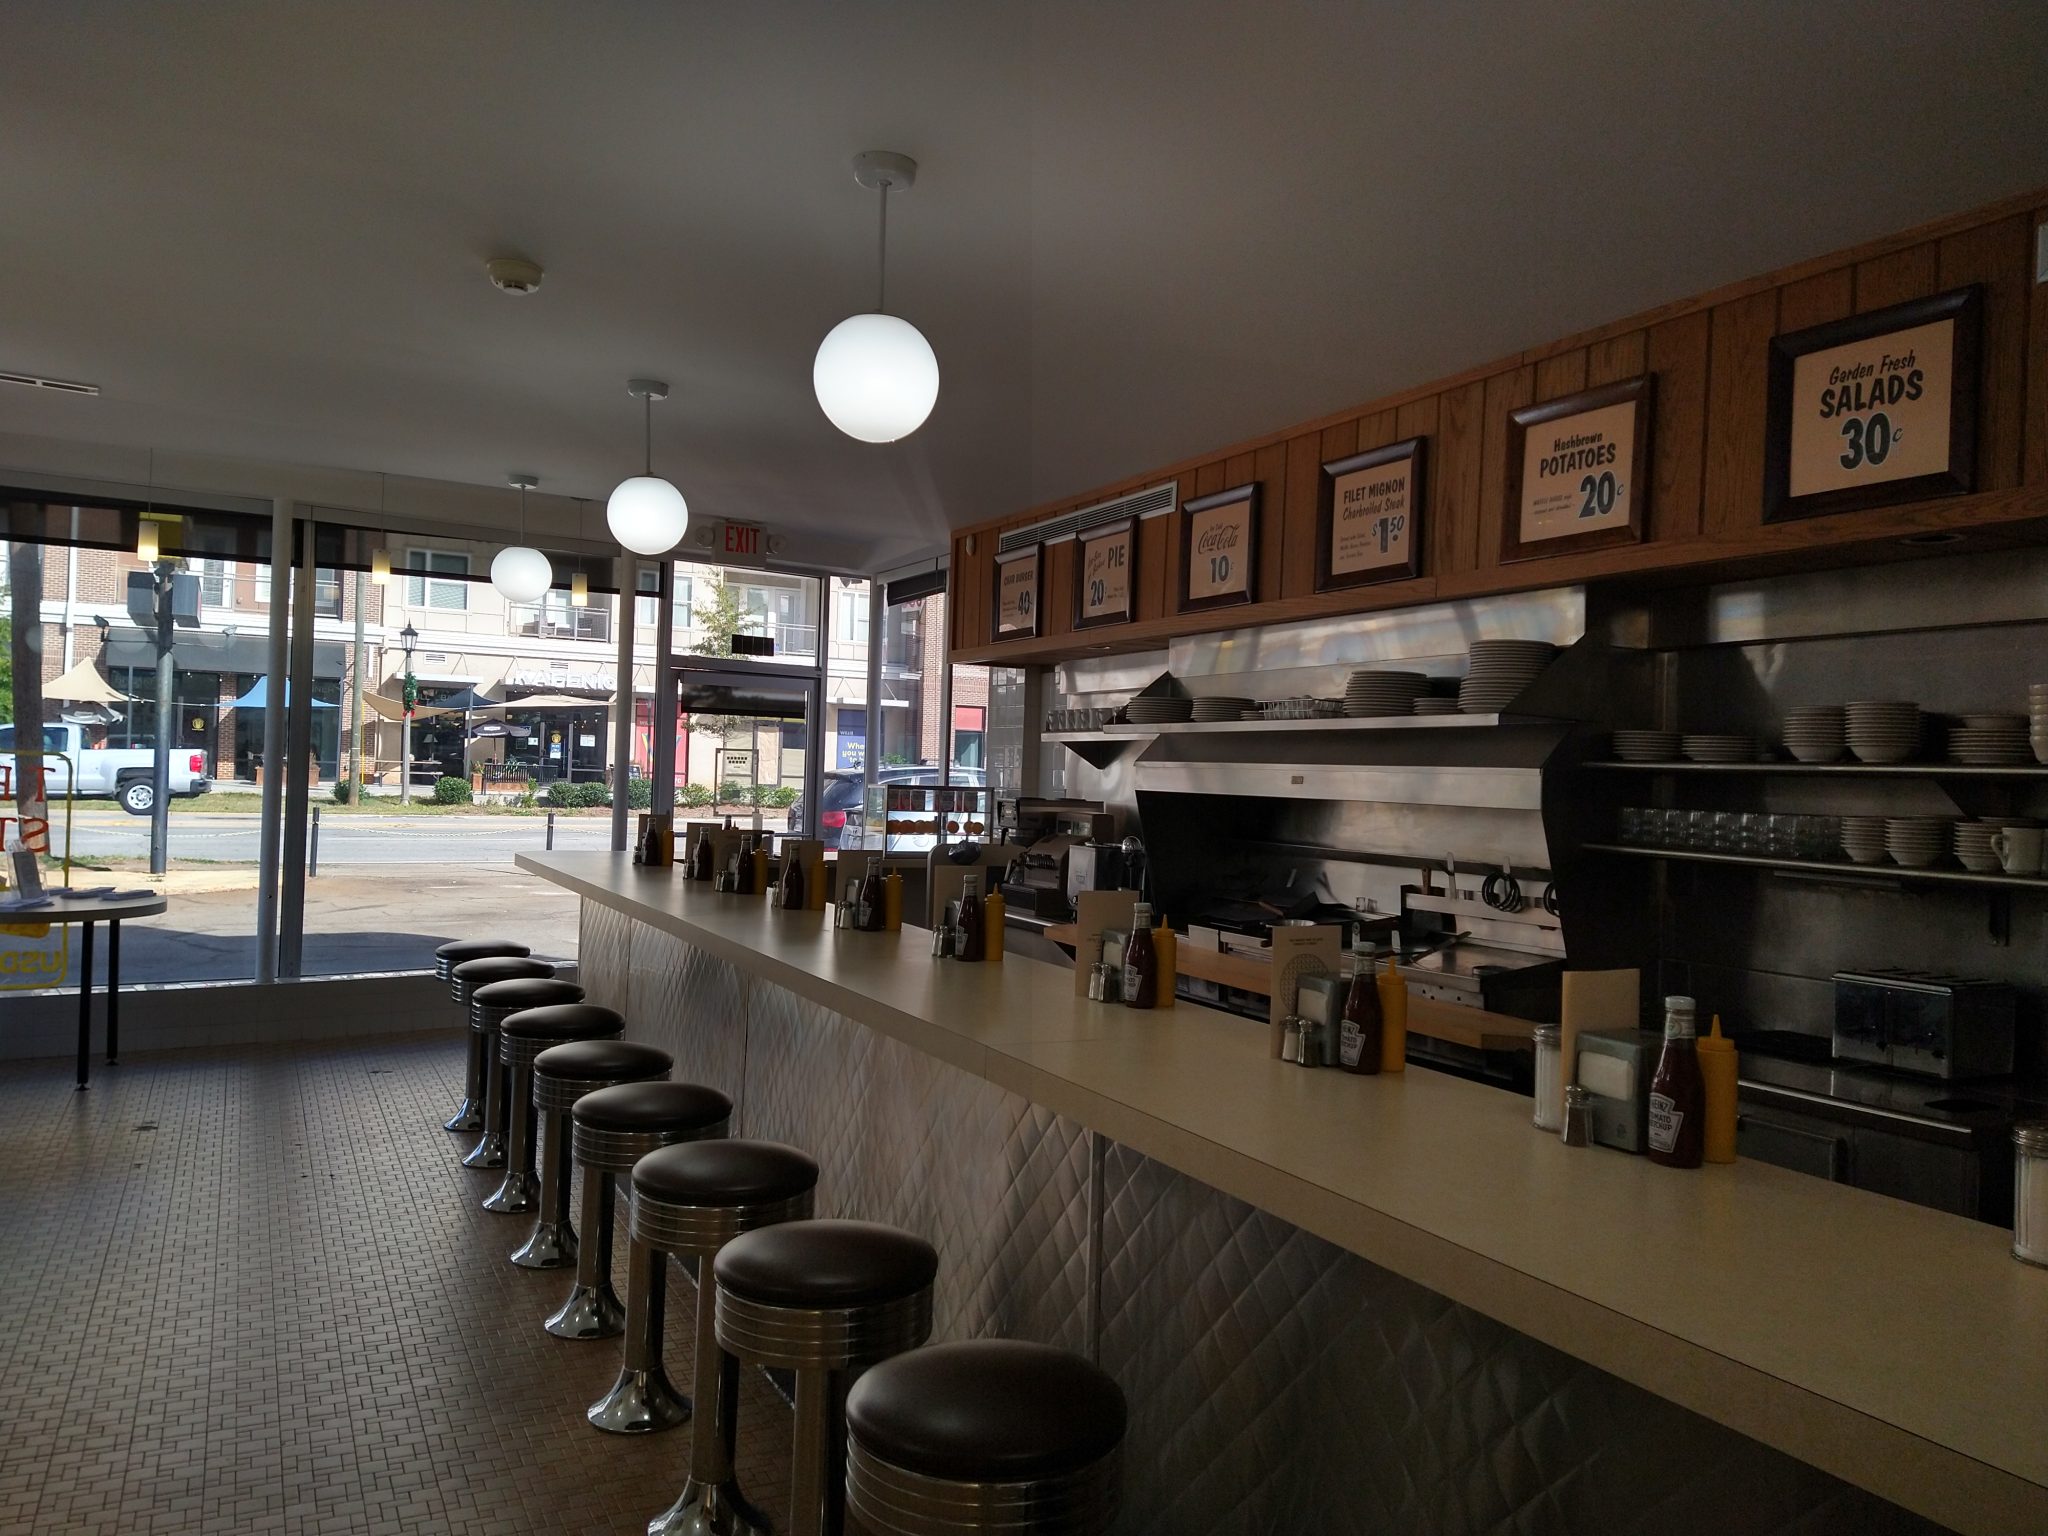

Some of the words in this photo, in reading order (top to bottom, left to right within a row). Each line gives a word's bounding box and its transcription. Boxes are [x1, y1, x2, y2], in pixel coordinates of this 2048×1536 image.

[1829, 362, 1874, 385] Garden
[1880, 349, 1916, 374] Fresh
[1819, 369, 1923, 418] SALADS
[1554, 432, 1603, 452] Hashbrown
[1539, 442, 1616, 478] POTATOES
[1343, 487, 1366, 505] FILET
[1368, 476, 1405, 499] MIGNON
[1343, 500, 1382, 521] Charbroiled
[1384, 495, 1405, 512] Steak
[725, 526, 760, 554] EXIT
[1108, 544, 1125, 569] PIE
